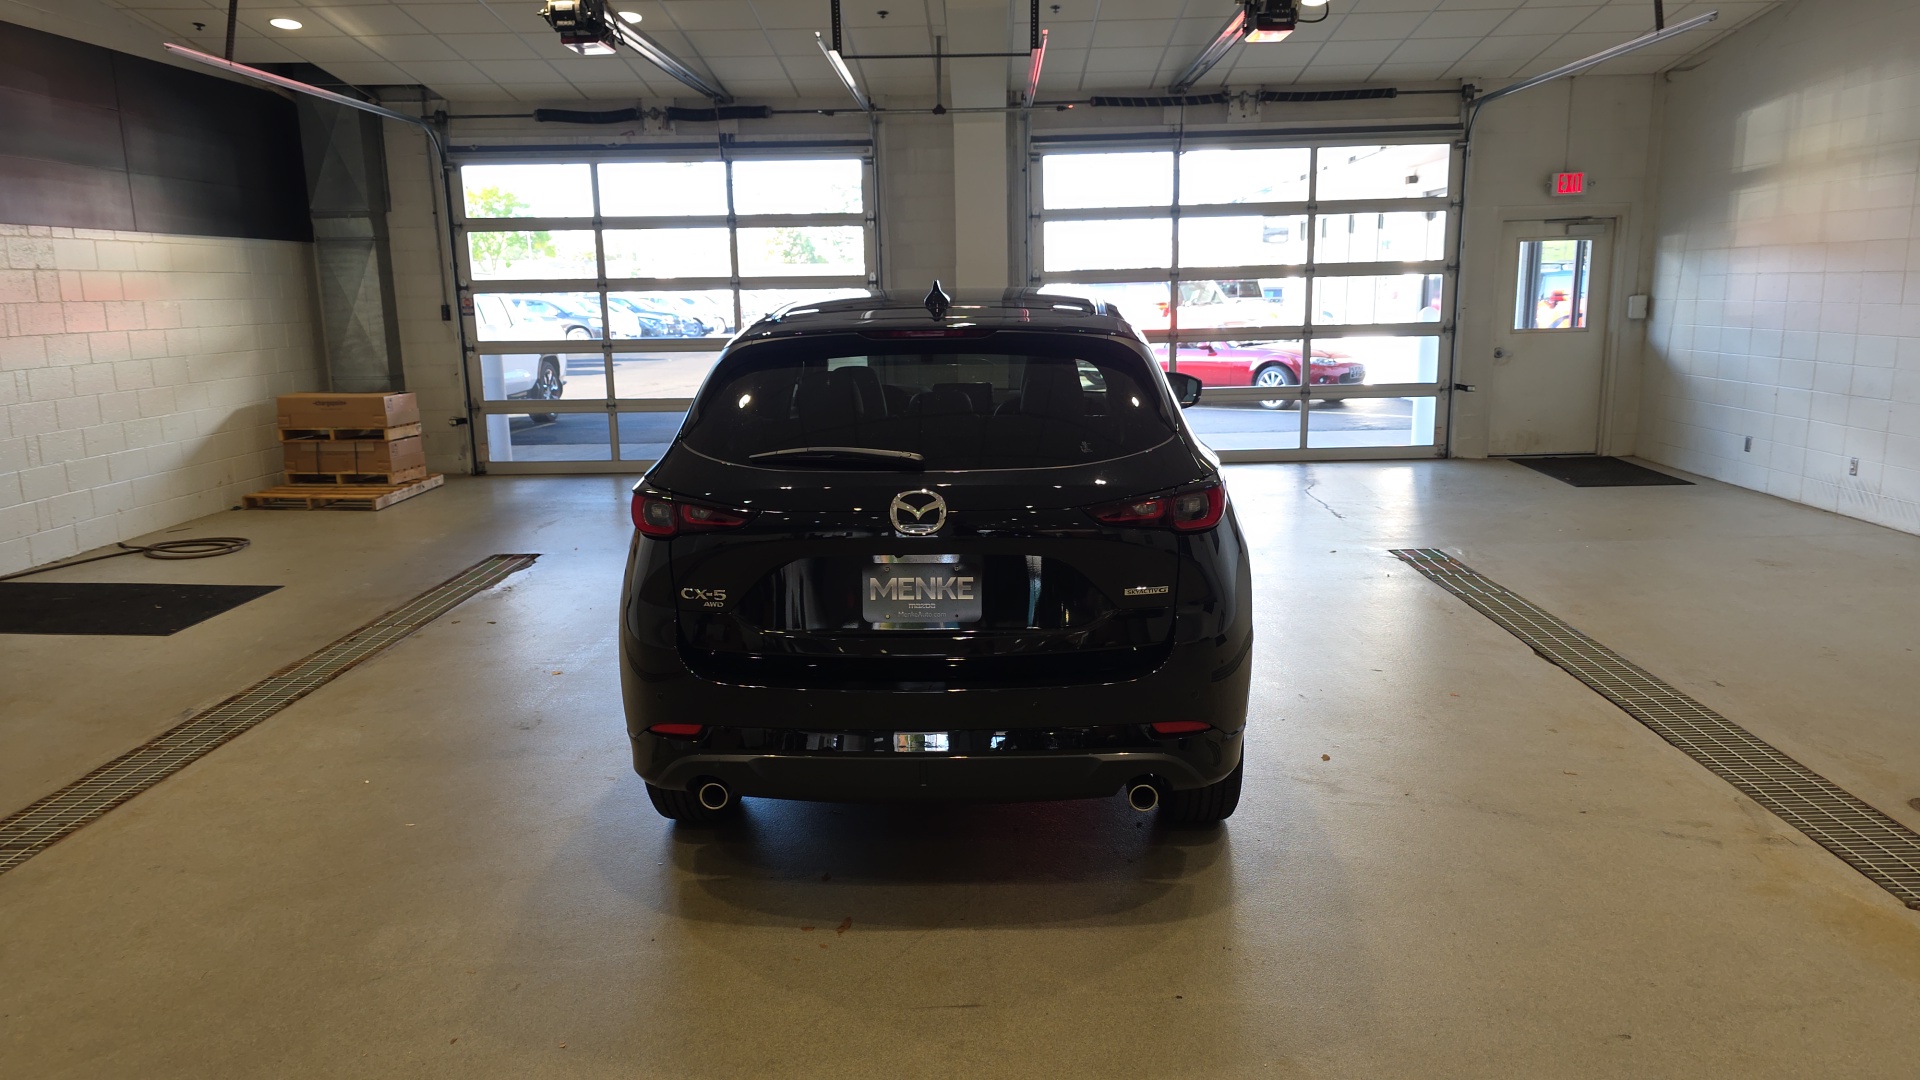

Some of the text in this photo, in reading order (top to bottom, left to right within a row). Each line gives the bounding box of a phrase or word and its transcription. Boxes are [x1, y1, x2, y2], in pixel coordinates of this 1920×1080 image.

[1557, 172, 1584, 194] EXIT
[680, 587, 727, 601] CX-5
[869, 576, 974, 600] MENKE
